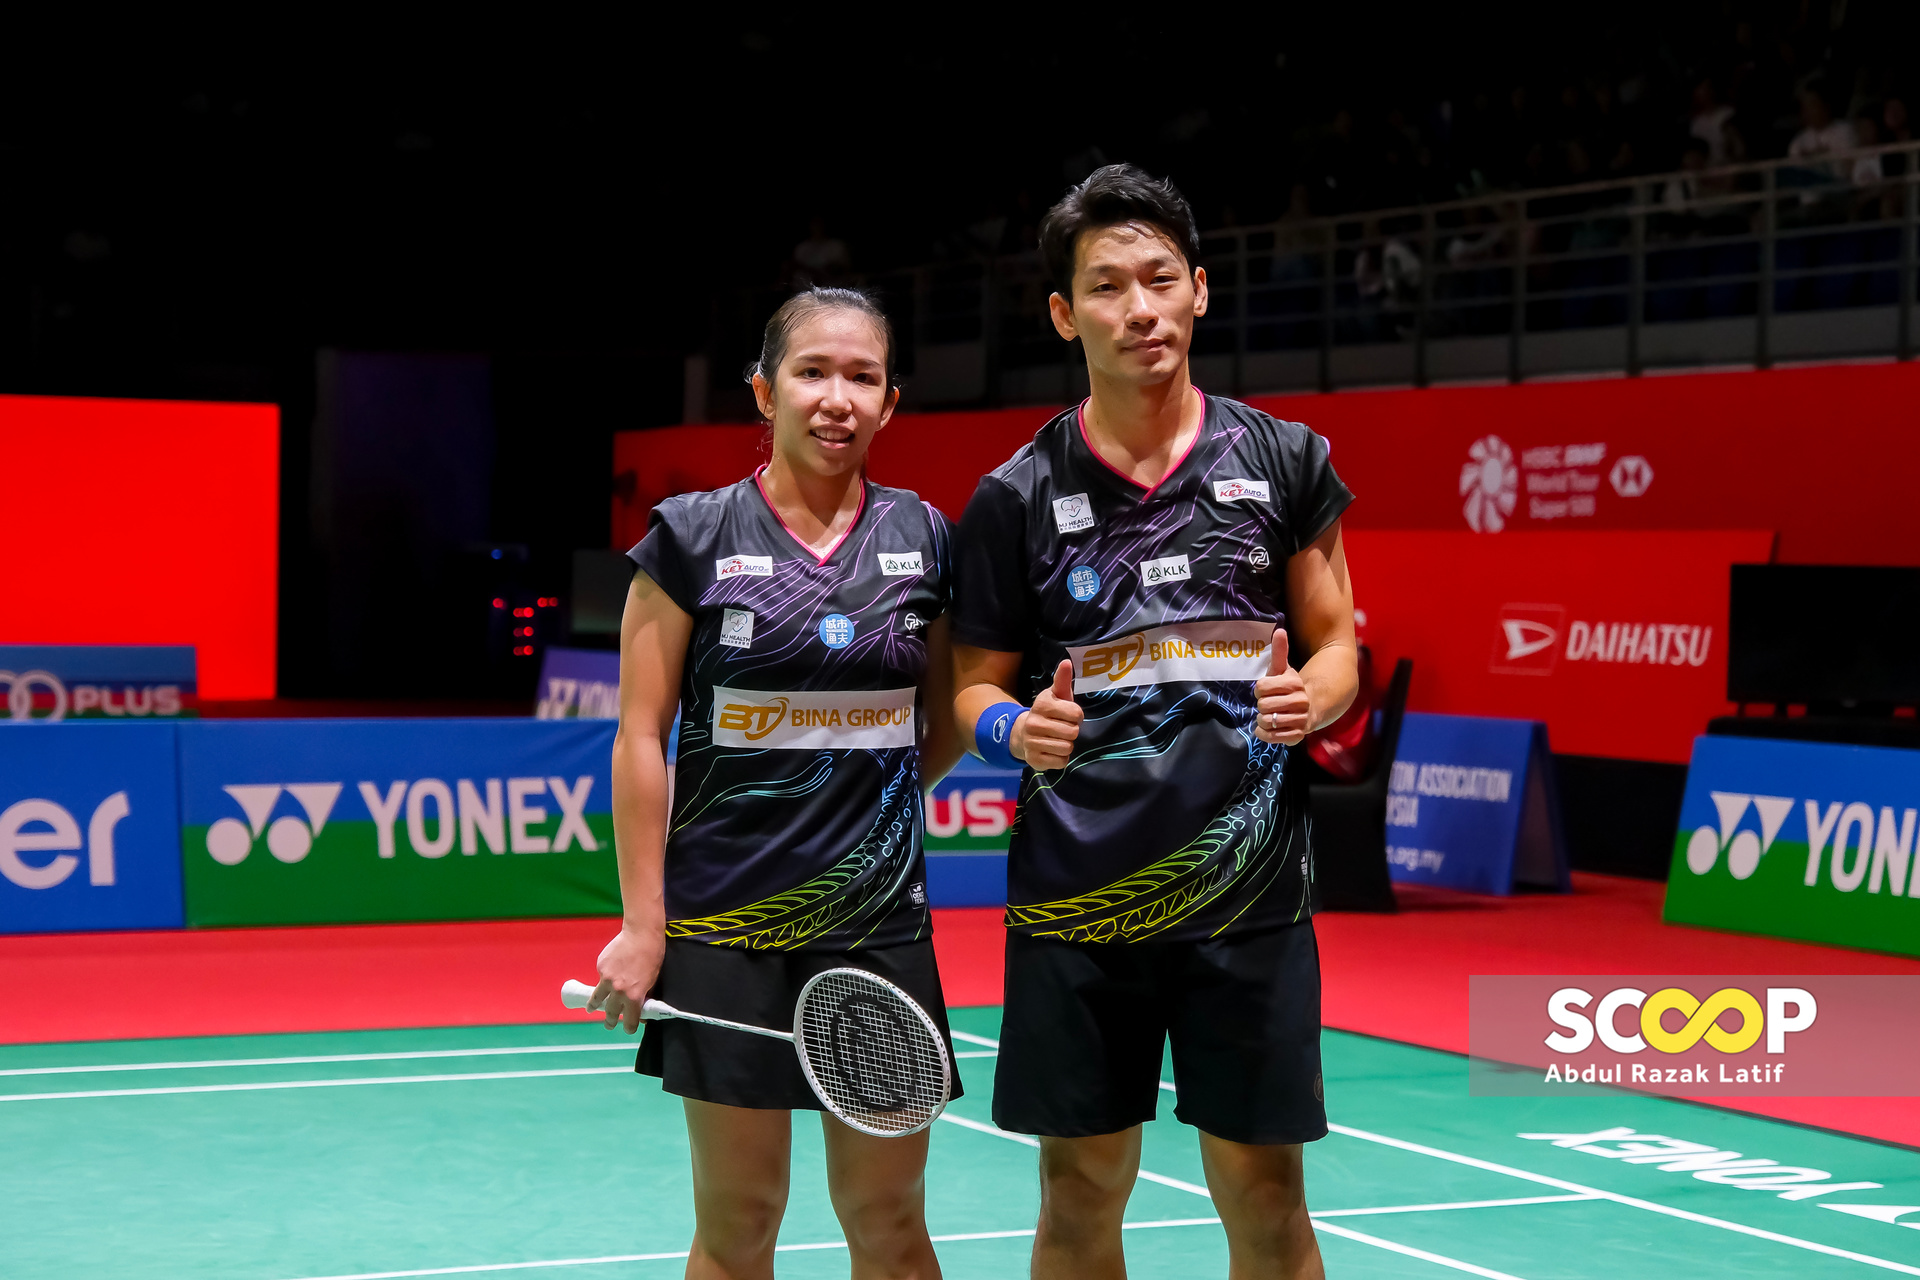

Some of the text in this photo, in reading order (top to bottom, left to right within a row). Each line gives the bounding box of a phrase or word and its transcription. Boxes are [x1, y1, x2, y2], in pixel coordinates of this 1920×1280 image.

[1220, 488, 1262, 498] KEY AUTO
[1069, 515, 1092, 526] HEALTH
[721, 564, 744, 575] KEY
[743, 564, 764, 572] AUTO
[900, 560, 922, 570] KLK
[1163, 563, 1187, 577] KLK
[1071, 570, 1093, 583] 城市
[825, 618, 848, 629] 城市
[729, 634, 751, 642] HEALTH
[1565, 620, 1712, 666] DAIHATSU
[1081, 635, 1266, 680] BT BINA GROUP
[73, 685, 182, 716] PLUS
[718, 700, 911, 736] BT BINA GROUP
[358, 776, 600, 859] YONEX
[0, 790, 130, 889] er
[1516, 1126, 1883, 1201] YONEX
